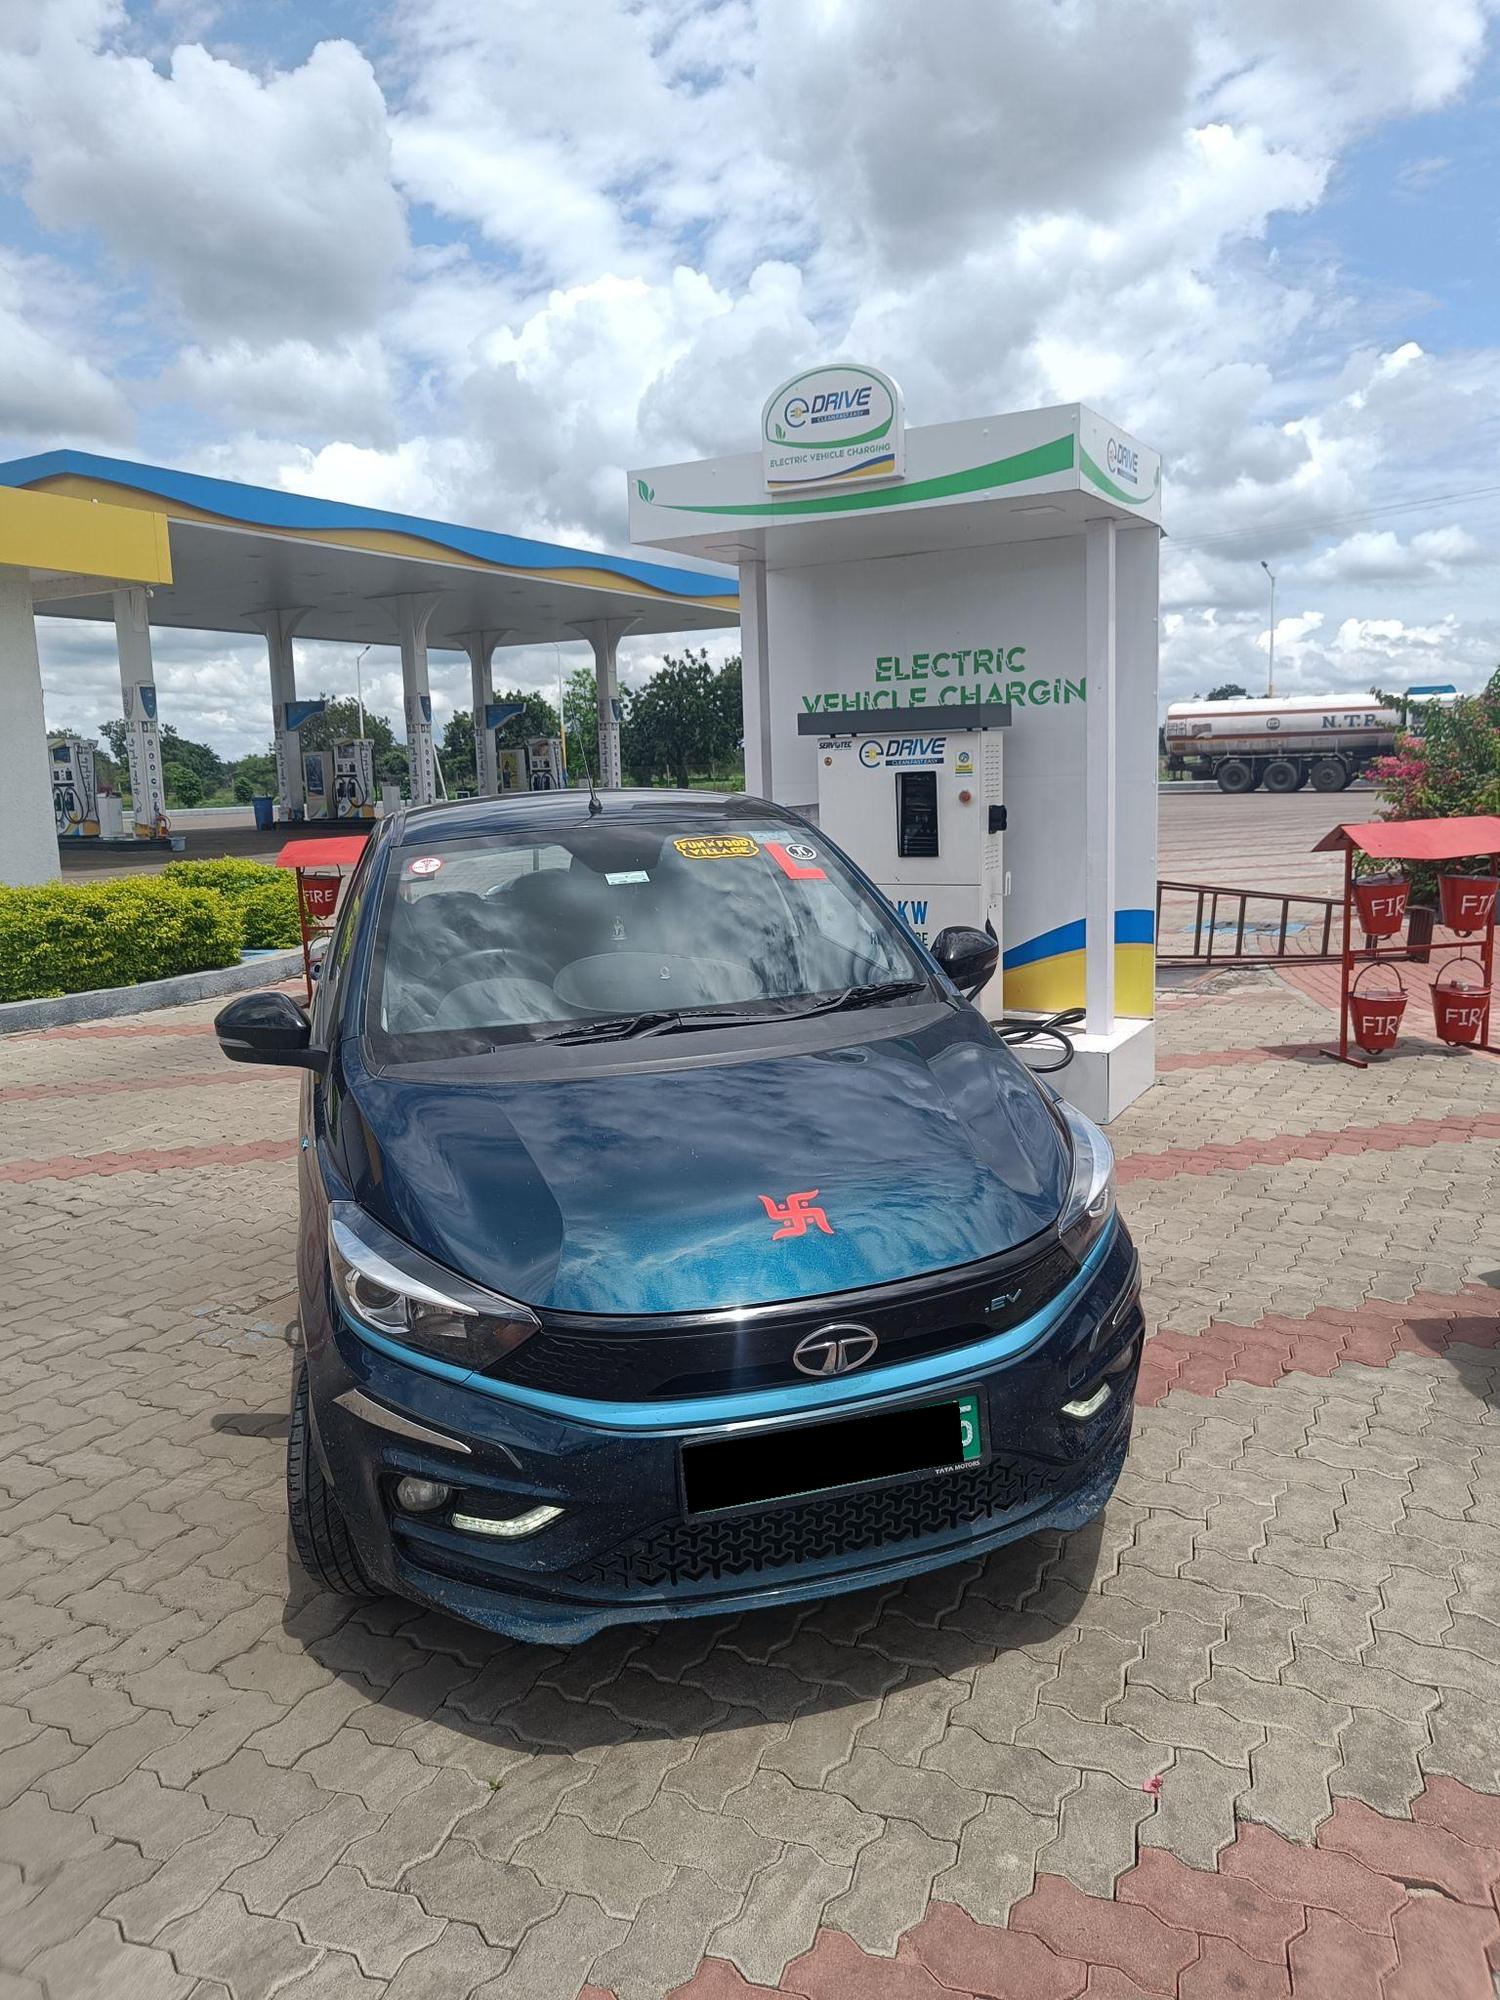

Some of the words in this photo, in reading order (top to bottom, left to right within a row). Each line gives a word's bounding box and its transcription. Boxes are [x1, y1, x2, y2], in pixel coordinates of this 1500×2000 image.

[769, 455, 808, 468] ELECTRIC
[810, 449, 845, 460] VEHICLE
[846, 442, 891, 456] CHARGING
[875, 647, 1026, 682] ELECTRIC
[938, 677, 1087, 707] CHARGIN
[679, 840, 706, 849] FUN
[716, 839, 749, 847] FOOD
[689, 846, 750, 855] VILLAGE
[1371, 895, 1406, 917] FIR
[1362, 1015, 1402, 1036] FIR
[935, 1466, 954, 1475] TATA
[954, 1460, 981, 1471] MOTORS
